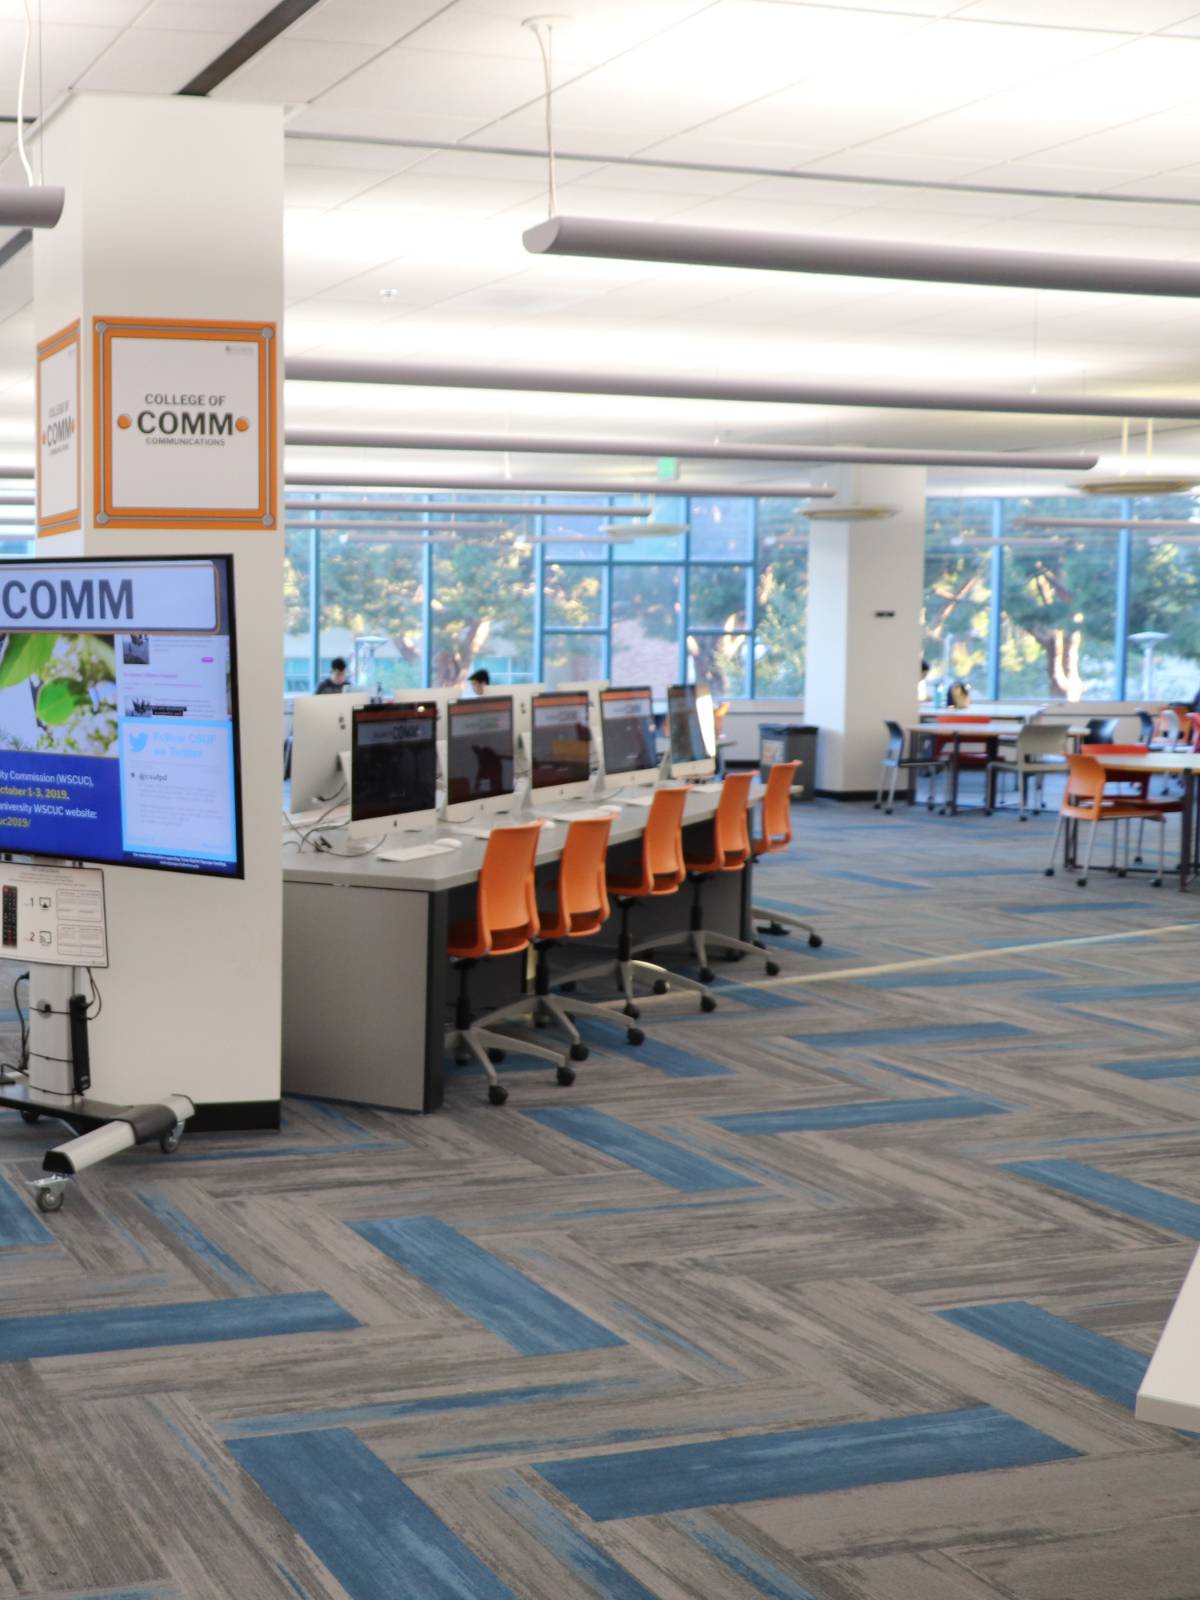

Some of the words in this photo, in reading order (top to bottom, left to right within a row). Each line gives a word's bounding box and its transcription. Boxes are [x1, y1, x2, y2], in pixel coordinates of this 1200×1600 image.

[144, 393, 205, 406] COLLEGE
[208, 395, 226, 407] OF
[138, 410, 233, 436] COMM
[145, 437, 226, 447] COMMUNICATIONS
[2, 578, 134, 620] COMM
[9, 770, 55, 783] Commission
[33, 804, 64, 816] WSCUC
